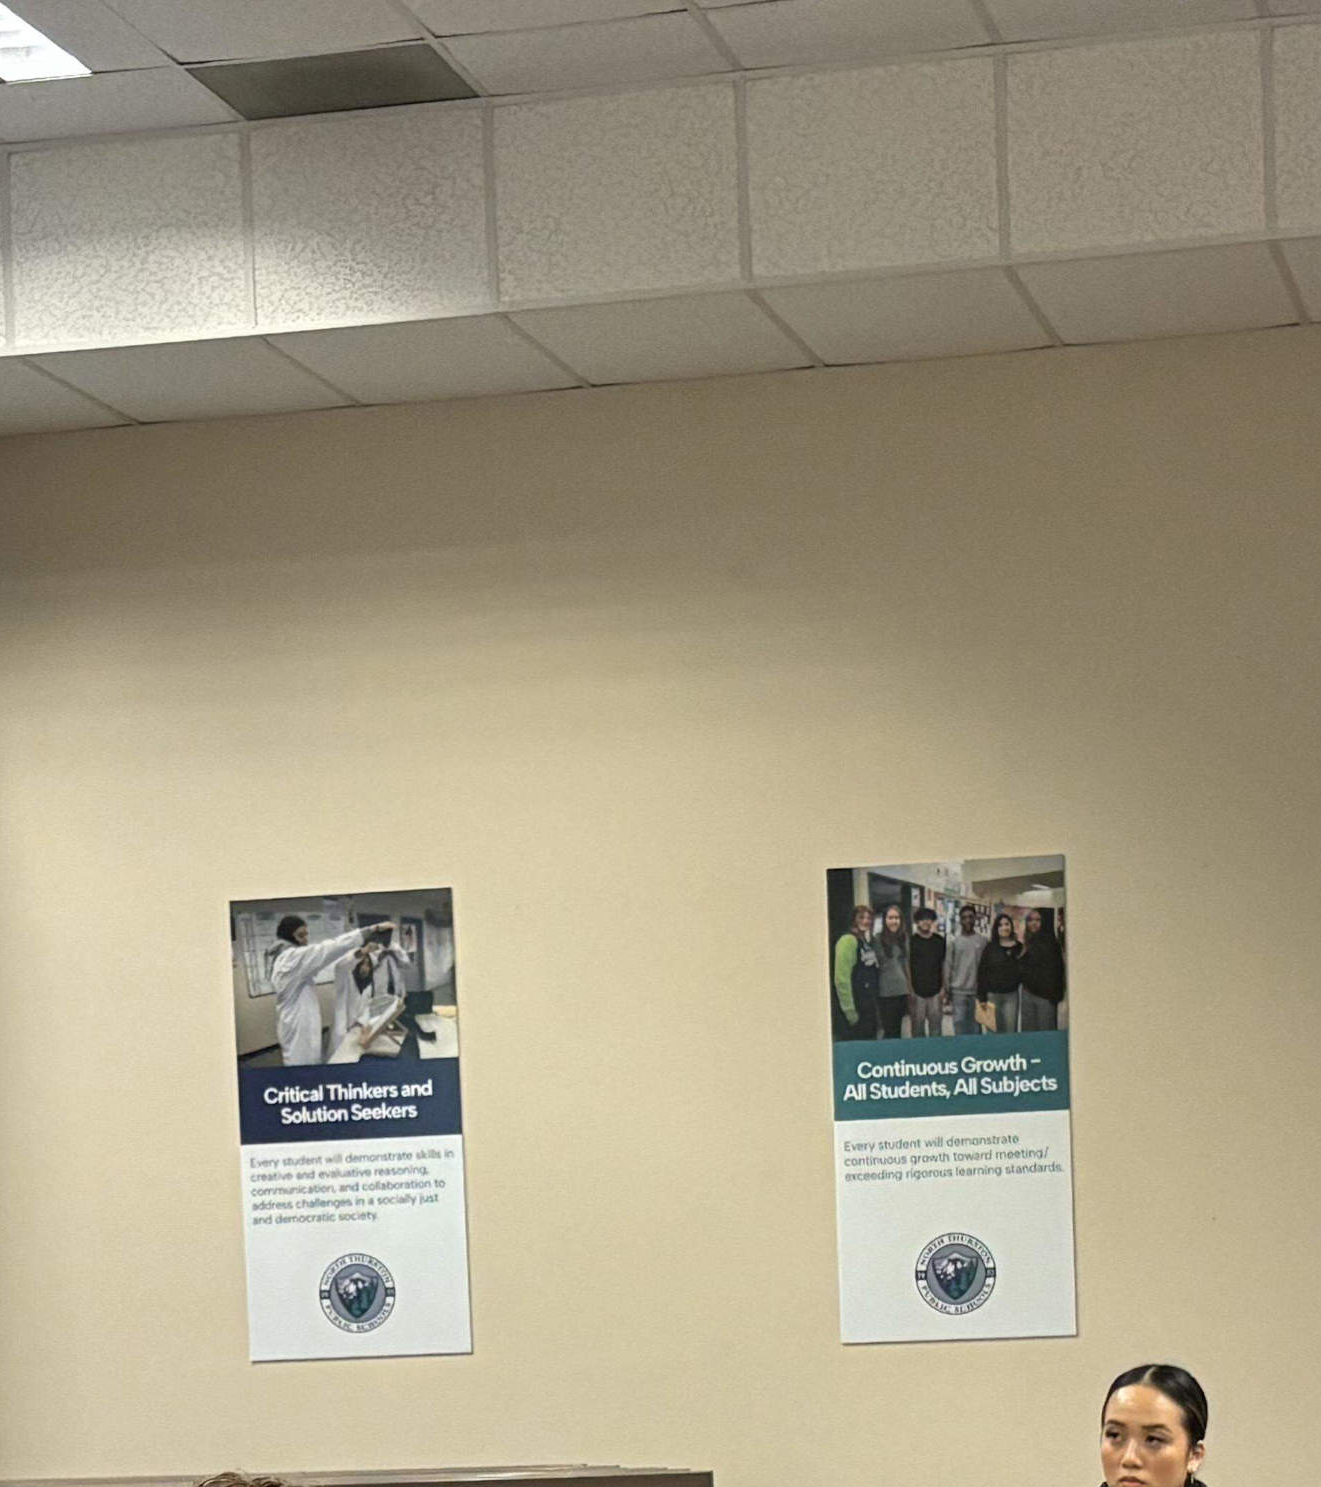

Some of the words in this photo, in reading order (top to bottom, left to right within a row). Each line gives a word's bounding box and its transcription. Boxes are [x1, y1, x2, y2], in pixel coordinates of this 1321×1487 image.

[857, 1060, 958, 1079] Continuous
[961, 1054, 1027, 1073] Growth
[264, 1085, 323, 1105] Critical
[327, 1083, 398, 1101] Thinkers
[401, 1079, 433, 1096] and
[843, 1084, 866, 1101] All
[870, 1081, 950, 1099] Students,
[953, 1079, 977, 1096] All
[981, 1075, 1057, 1097] Subjects
[281, 1107, 348, 1124] Solution
[351, 1104, 417, 1120] Seekers
[844, 1141, 875, 1152] Every
[879, 1138, 921, 1149] student
[925, 1137, 943, 1147] will
[946, 1135, 1019, 1147] demonstrate
[250, 1157, 279, 1169] Every
[282, 1155, 322, 1166] student
[325, 1154, 342, 1163] will
[345, 1151, 412, 1164] demonstrate
[416, 1150, 441, 1160] skills
[444, 1149, 454, 1159] in
[844, 1154, 907, 1166] continuous
[910, 1152, 949, 1166] growth
[953, 1150, 992, 1161] toward
[251, 1172, 293, 1182] creative
[296, 1170, 315, 1180] and
[318, 1167, 371, 1179] evaluative
[374, 1165, 429, 1177] reasoning,
[845, 1168, 902, 1182] exceeding
[906, 1167, 952, 1179] rigorous
[956, 1165, 1002, 1177] learning
[1005, 1163, 1064, 1174] standards.
[251, 1184, 335, 1197] communication,
[339, 1182, 359, 1192] and
[362, 1179, 432, 1190] collaboration
[435, 1179, 445, 1189] to
[252, 1199, 293, 1210] address
[296, 1197, 353, 1210] challenges
[356, 1196, 364, 1206] in
[367, 1198, 374, 1206] a
[377, 1193, 416, 1206] socially
[418, 1193, 438, 1204] just
[253, 1215, 272, 1225] and
[275, 1212, 335, 1224] democratic
